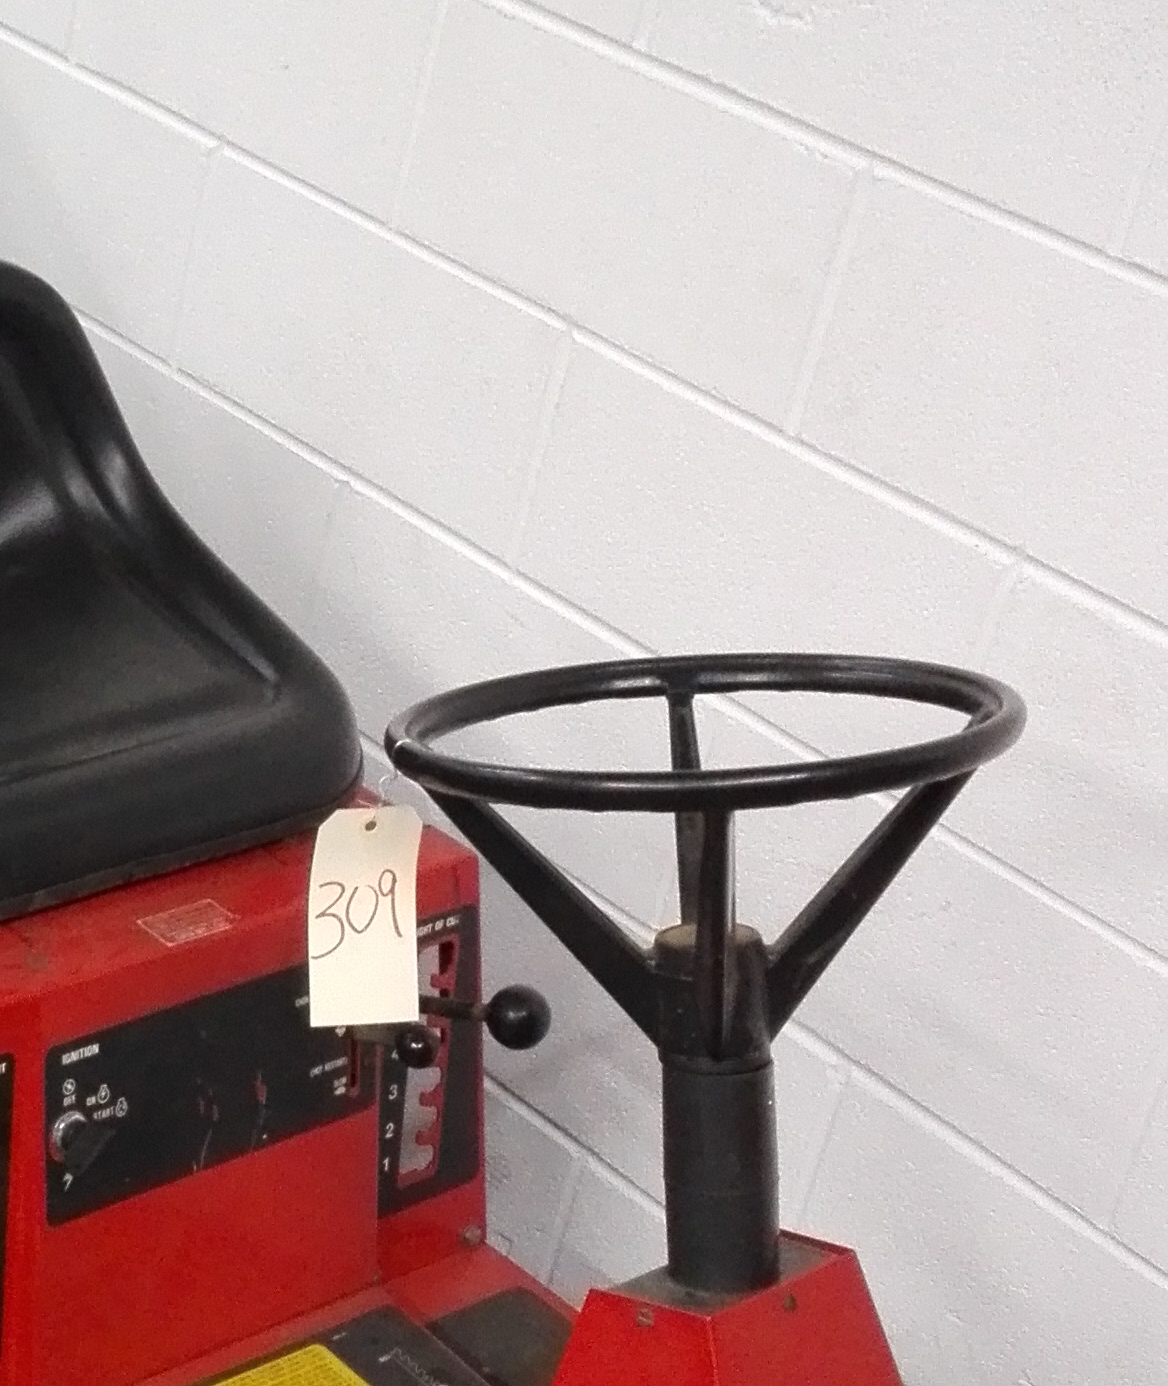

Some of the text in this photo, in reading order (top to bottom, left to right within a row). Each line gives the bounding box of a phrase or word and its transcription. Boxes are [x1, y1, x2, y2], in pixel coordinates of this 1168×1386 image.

[310, 869, 403, 960] 309
[62, 1043, 100, 1066] IGNITION
[388, 1084, 398, 1100] 3
[385, 1122, 394, 1139] 2
[382, 1157, 389, 1171] 1
